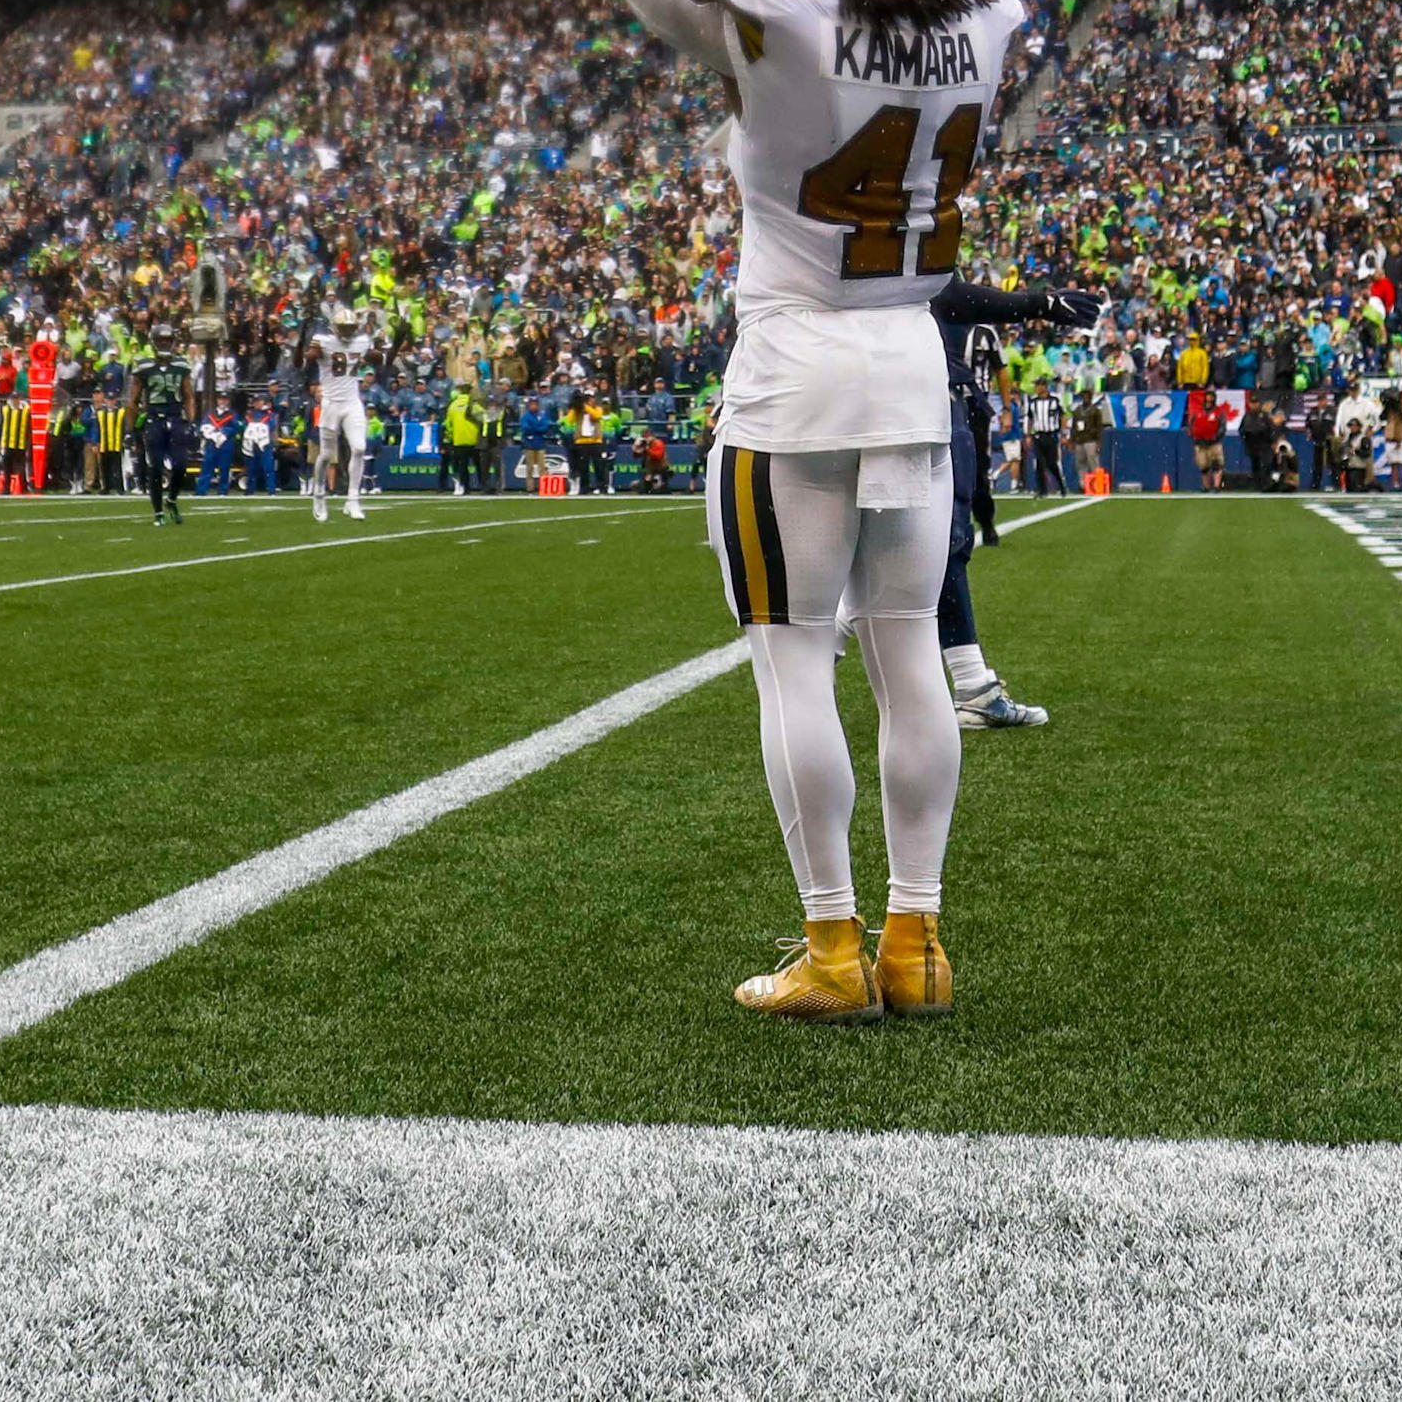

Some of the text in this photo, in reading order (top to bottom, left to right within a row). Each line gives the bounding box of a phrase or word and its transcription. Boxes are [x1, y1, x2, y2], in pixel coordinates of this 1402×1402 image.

[834, 25, 980, 86] KAMARA
[798, 101, 983, 281] 41
[1120, 394, 1174, 430] 12
[542, 476, 560, 495] 10
